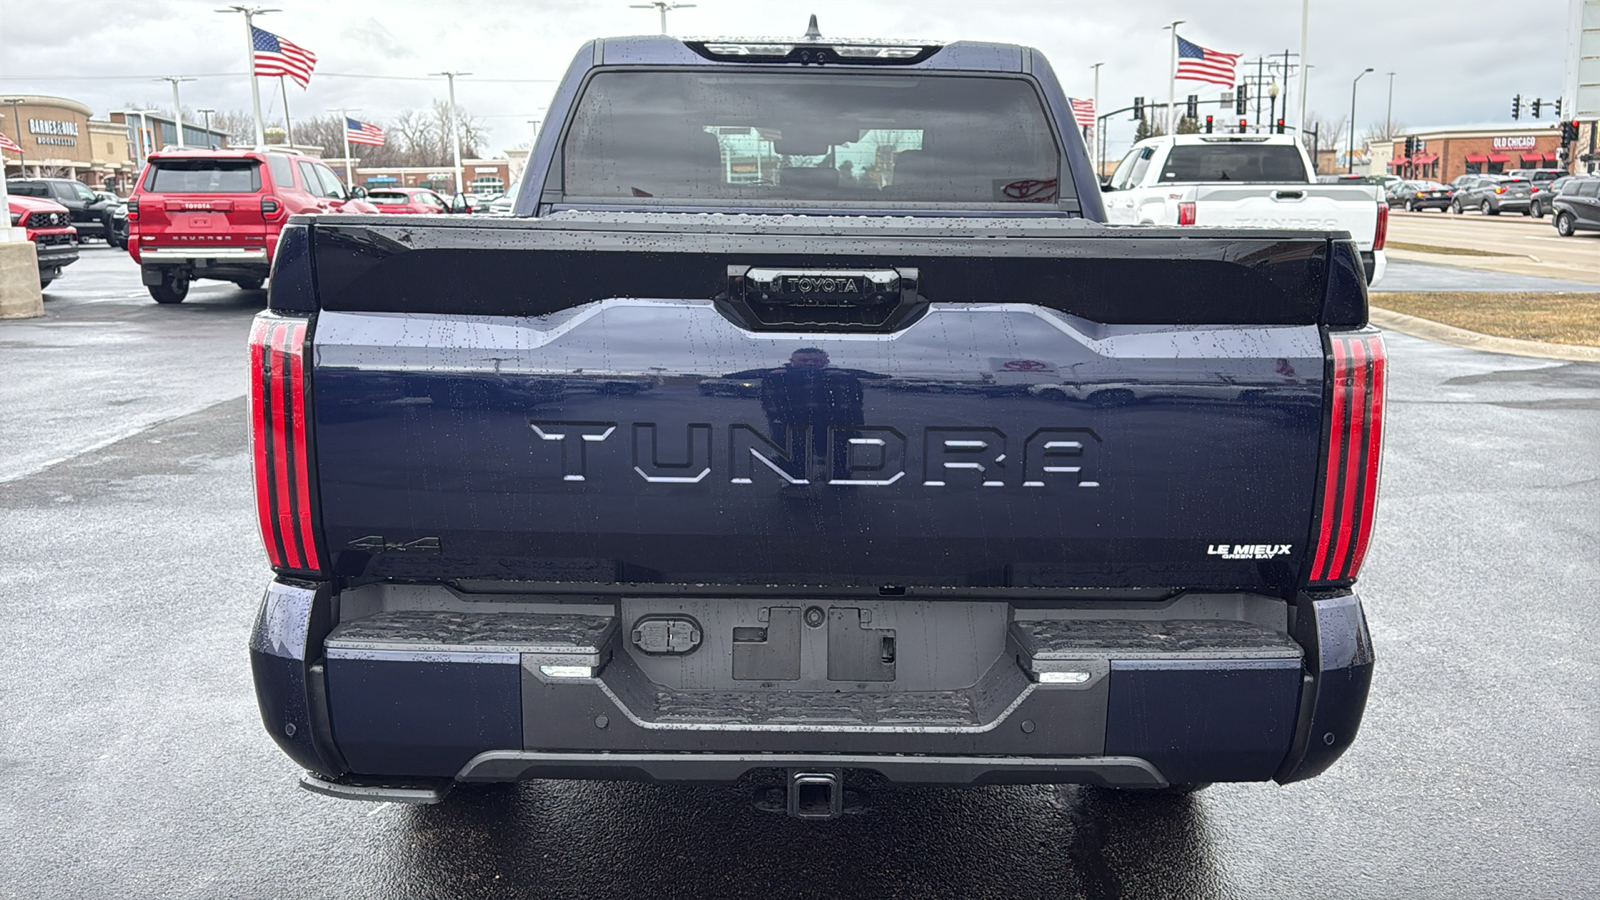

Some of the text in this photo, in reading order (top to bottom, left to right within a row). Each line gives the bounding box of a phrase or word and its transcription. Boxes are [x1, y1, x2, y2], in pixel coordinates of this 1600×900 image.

[1493, 136, 1536, 148] OLD CHICAGO
[787, 277, 859, 293] TOYOTA
[529, 420, 1103, 488] TUNDRA
[1207, 544, 1293, 555] LE MIEUX
